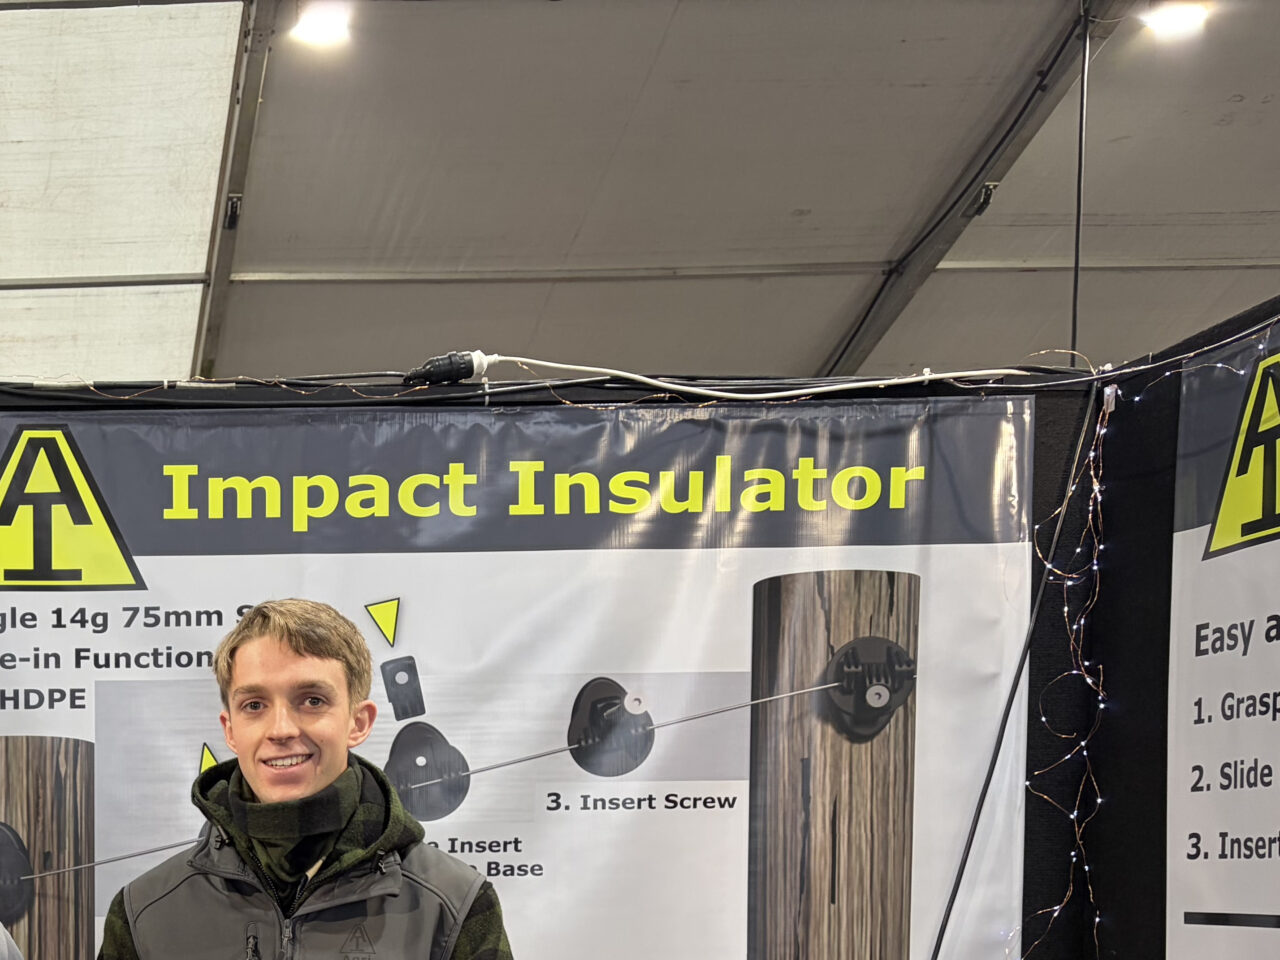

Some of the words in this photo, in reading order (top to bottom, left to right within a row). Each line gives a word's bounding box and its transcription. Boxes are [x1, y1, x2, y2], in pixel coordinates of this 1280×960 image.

[162, 462, 477, 532] Impact
[508, 454, 925, 516] Insulator
[51, 607, 109, 634] 14g
[122, 606, 223, 628] 75mm
[1195, 619, 1255, 657] Easy
[1193, 697, 1213, 725] 1.
[1190, 765, 1211, 792] 2.
[1219, 758, 1273, 790] Slide
[546, 792, 570, 811] 3.
[580, 794, 656, 810] Insert
[664, 793, 737, 810] Screw
[447, 837, 522, 853] Insert
[1186, 832, 1209, 860] 3.
[1218, 831, 1280, 860] Inser
[486, 861, 543, 877] Base
